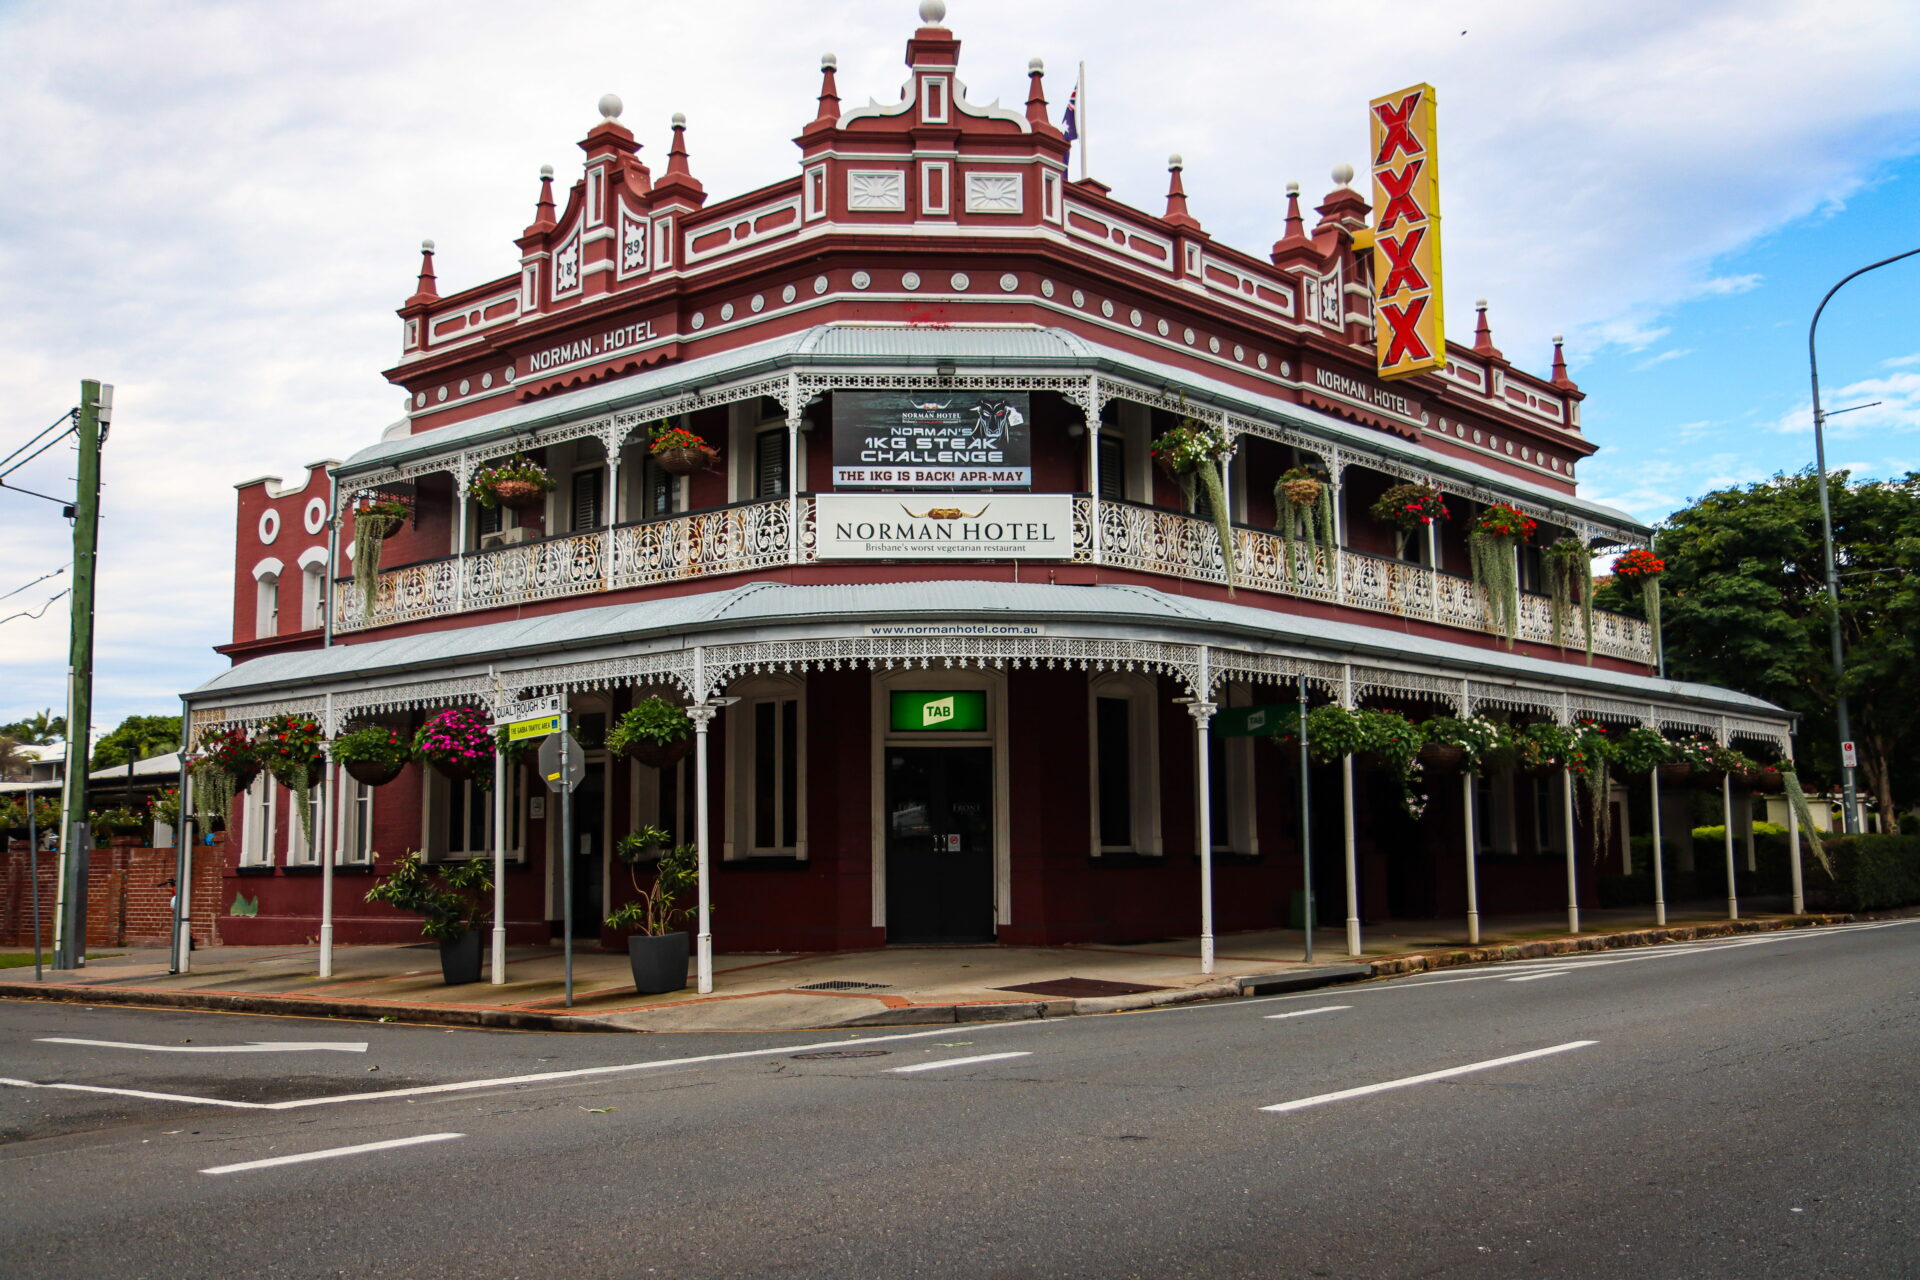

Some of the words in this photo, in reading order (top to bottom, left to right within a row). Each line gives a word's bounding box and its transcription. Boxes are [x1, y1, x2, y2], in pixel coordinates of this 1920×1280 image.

[1370, 89, 1433, 370] XXXX
[626, 239, 641, 256] 89
[603, 320, 658, 351] HOTEL
[1373, 387, 1412, 416] HOTEL
[890, 427, 973, 437] NORMAN'S
[865, 437, 907, 449] 1KG
[916, 437, 998, 449] STEAK
[860, 450, 1004, 463] CHALLENGE
[839, 471, 865, 481] THE
[870, 471, 892, 481] 1KG
[897, 471, 910, 481] IS
[915, 471, 955, 482] BACK!
[960, 471, 1023, 482] APR-MAY
[836, 522, 952, 540] NORMAN
[963, 522, 1056, 541] HOTEL
[865, 543, 908, 552] Brisbane's
[910, 544, 934, 552] worst
[936, 544, 981, 553] vegetarian
[983, 544, 1026, 552] restaurant
[871, 625, 1038, 634] www.normanhotel.com.au
[496, 701, 538, 718] QUALTROUGH
[541, 698, 548, 710] ST
[926, 706, 951, 717] TAB
